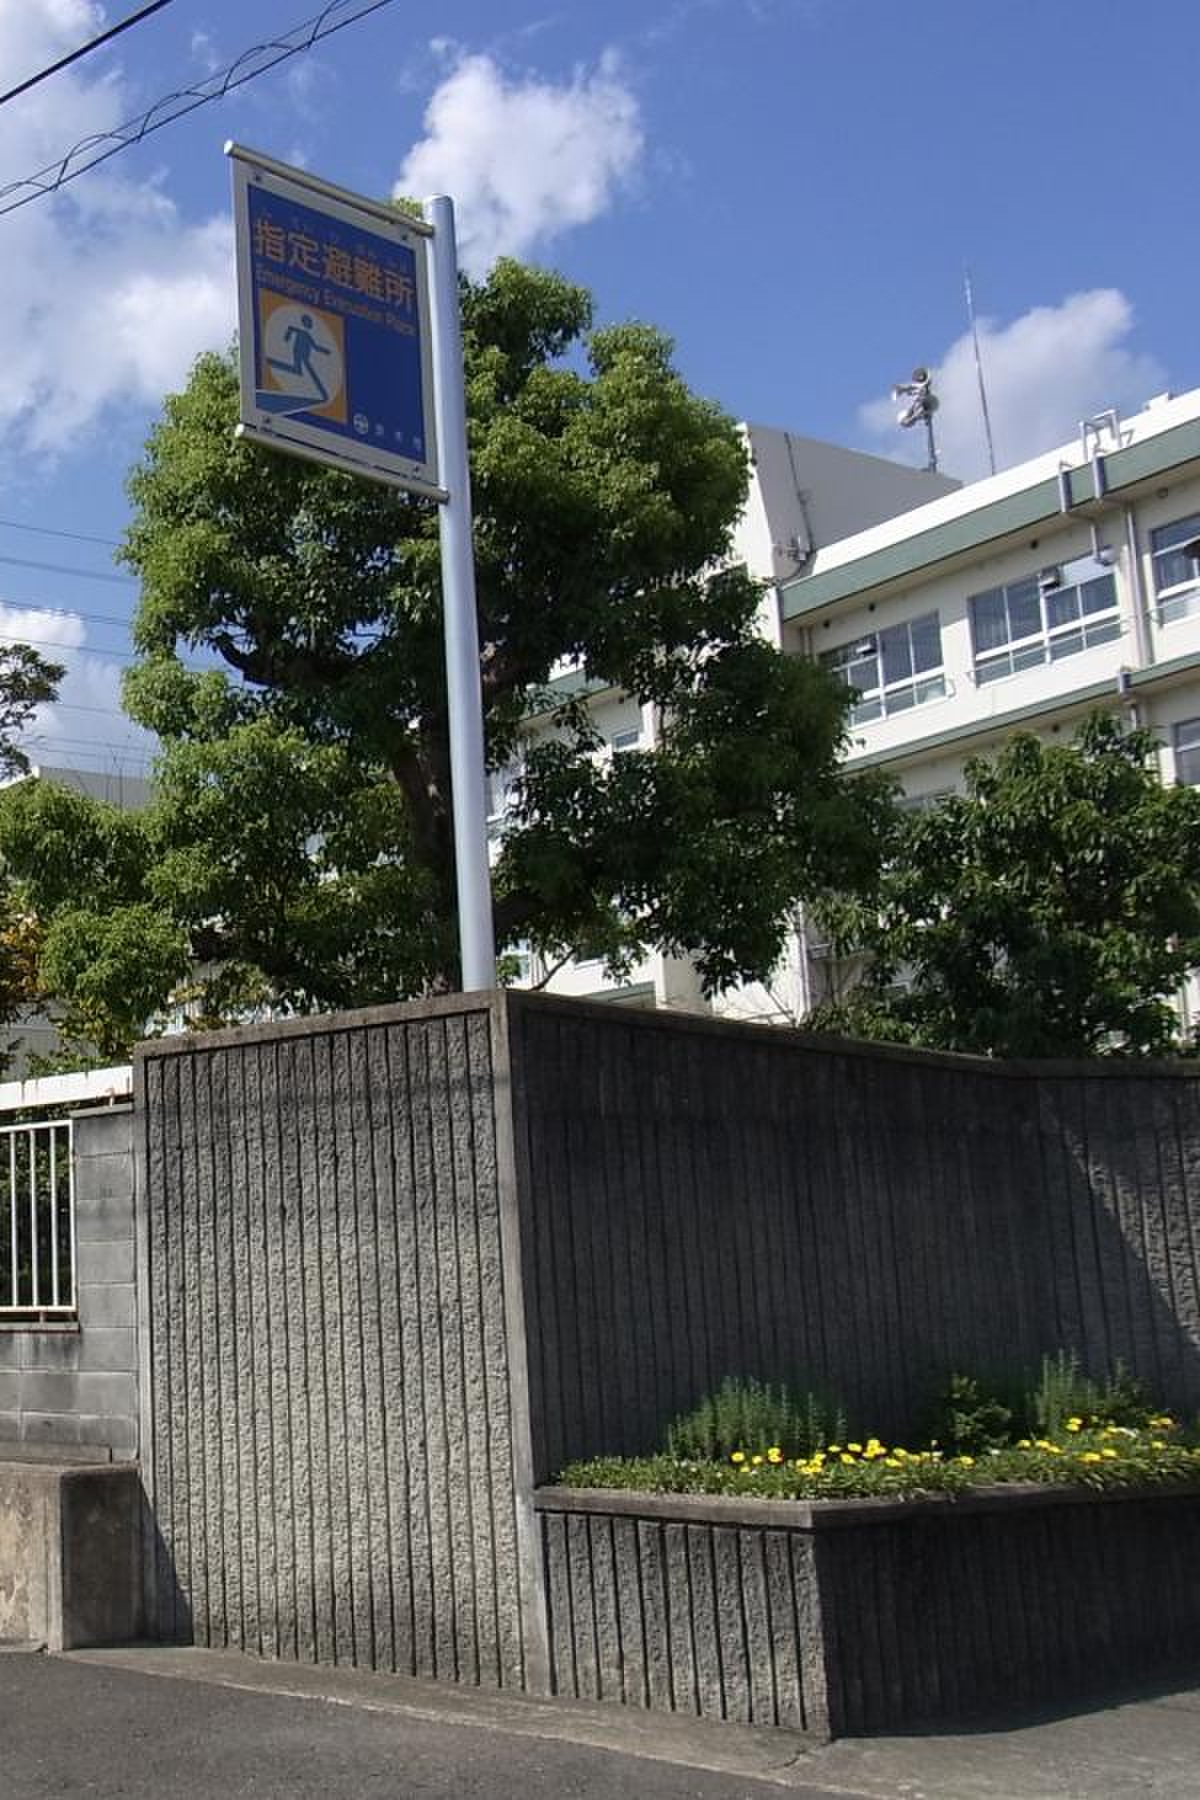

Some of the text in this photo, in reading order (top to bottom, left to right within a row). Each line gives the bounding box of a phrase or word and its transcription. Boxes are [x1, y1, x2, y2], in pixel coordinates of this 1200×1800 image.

[256, 214, 415, 307] 指定避難所
